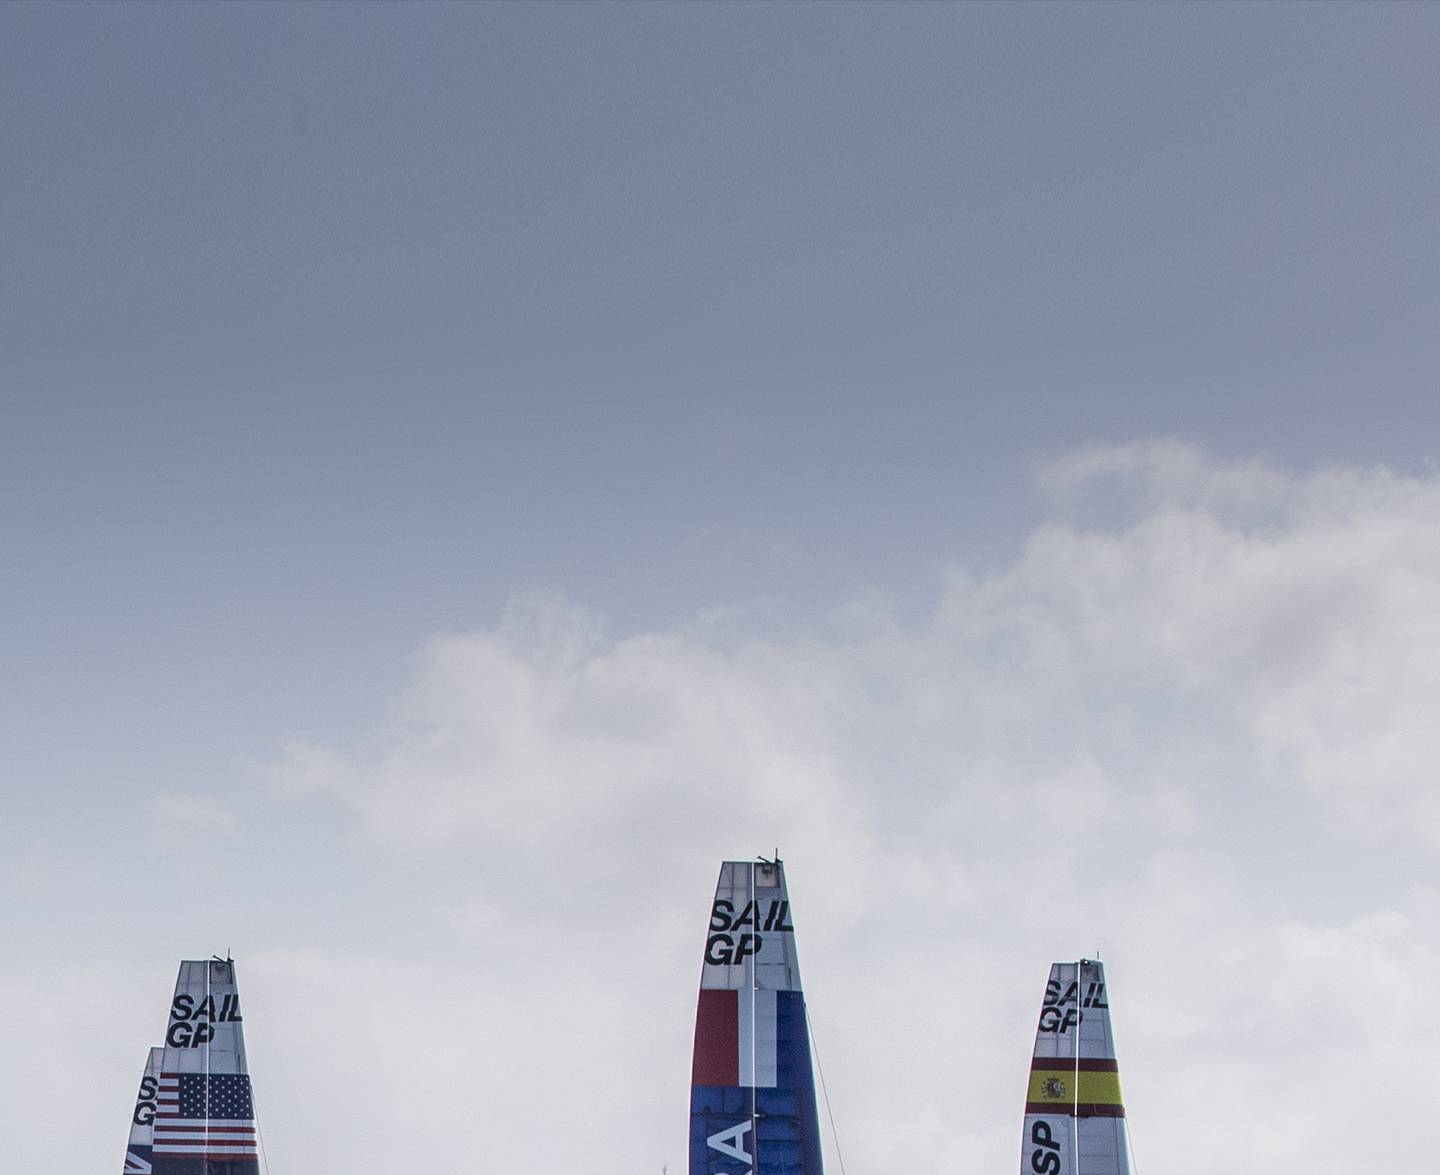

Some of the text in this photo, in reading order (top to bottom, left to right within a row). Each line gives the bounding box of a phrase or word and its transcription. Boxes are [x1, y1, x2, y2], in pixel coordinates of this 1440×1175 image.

[709, 900, 795, 932] SAIL
[703, 934, 763, 966] GP
[170, 994, 243, 1022] SAIL
[1043, 980, 1109, 1008] SAIL
[1038, 1007, 1083, 1033] GP
[166, 1022, 215, 1049] GP
[133, 1101, 157, 1126] G
